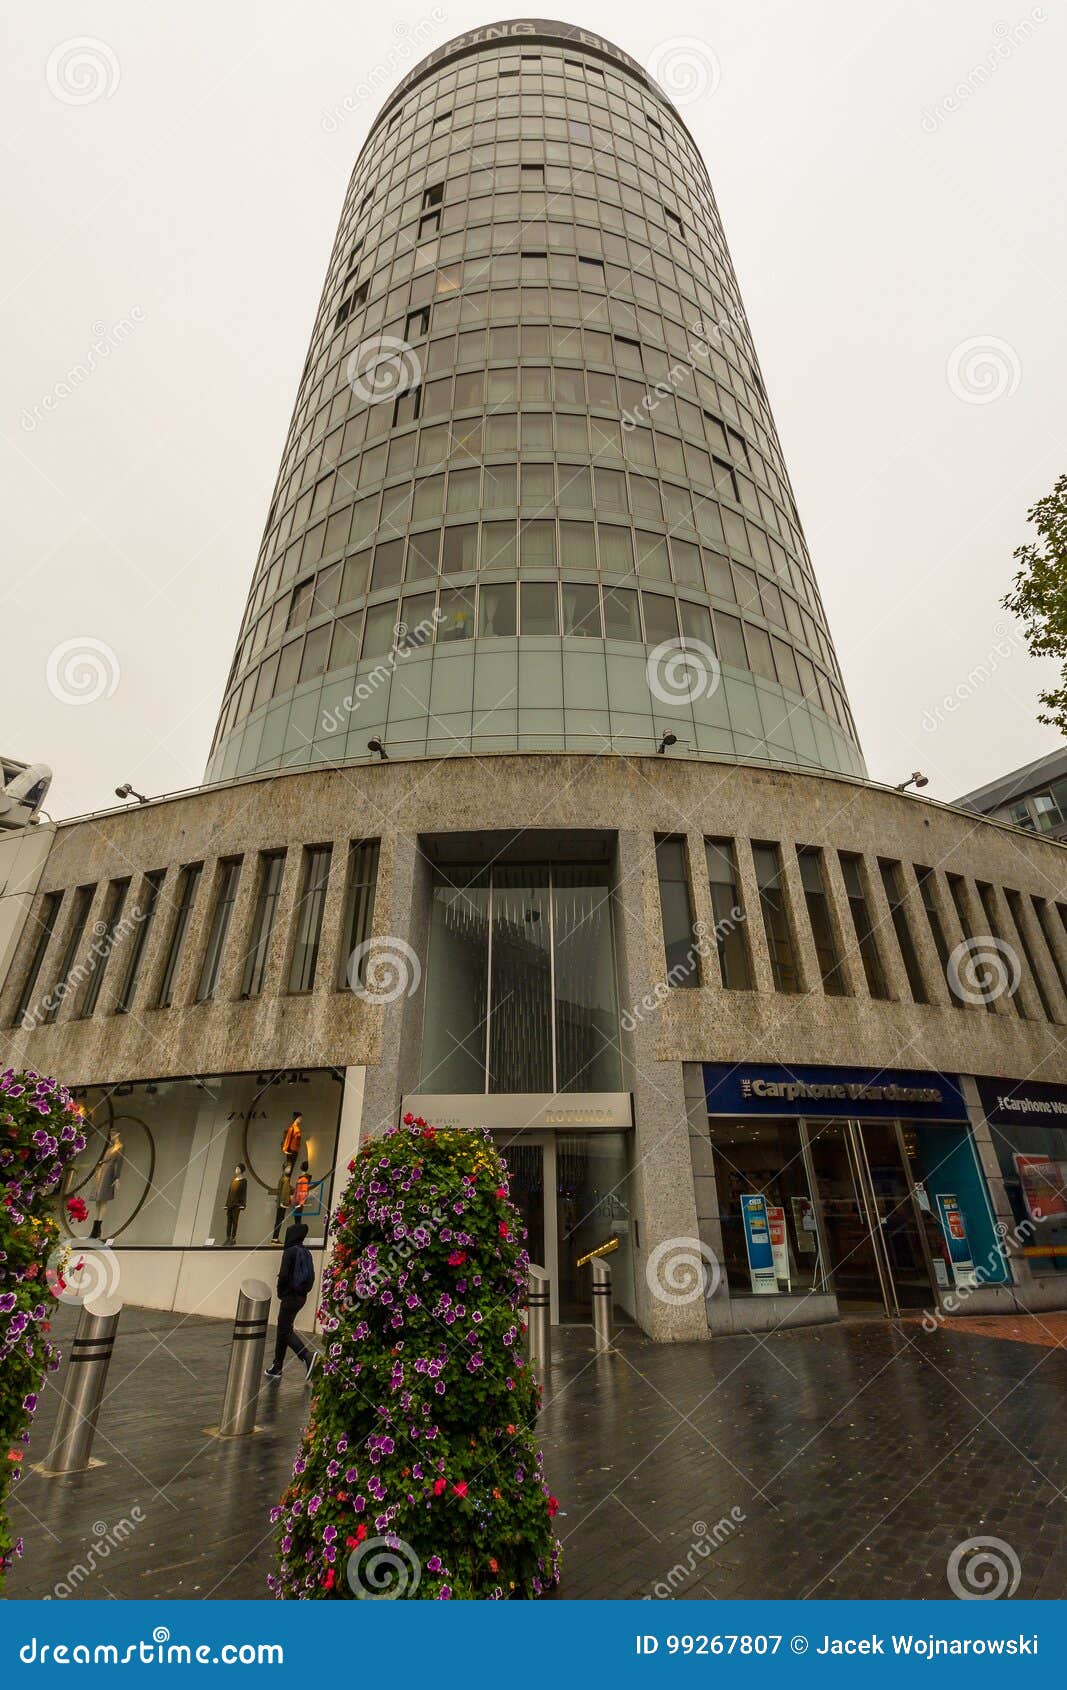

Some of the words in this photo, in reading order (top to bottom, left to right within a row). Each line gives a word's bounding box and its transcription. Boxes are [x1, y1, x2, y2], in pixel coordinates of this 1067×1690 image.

[741, 1078, 751, 1098] THE
[751, 1079, 846, 1101] Carphone
[848, 1083, 943, 1102] Warehouse
[1003, 1096, 1052, 1113] Carphone
